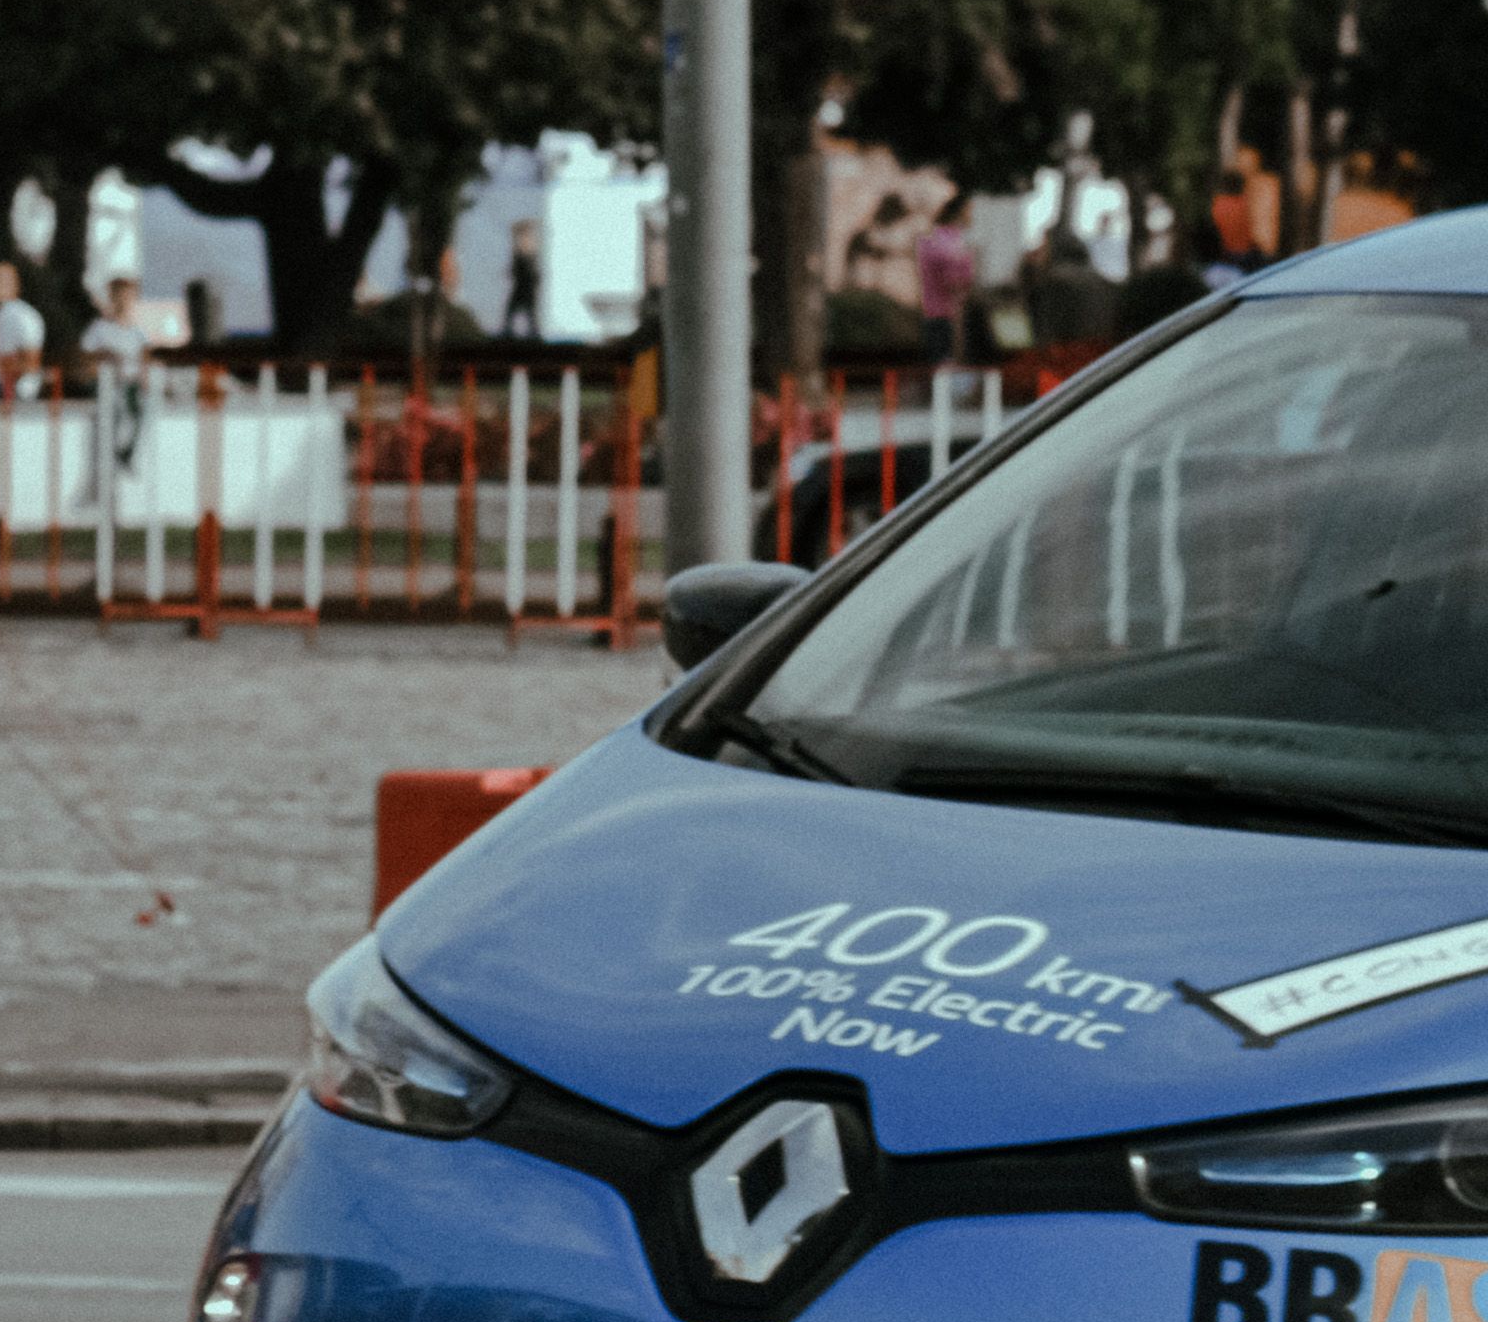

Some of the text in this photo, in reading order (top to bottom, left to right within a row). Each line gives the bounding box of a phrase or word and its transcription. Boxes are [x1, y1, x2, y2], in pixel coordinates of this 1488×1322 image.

[726, 901, 1175, 1015] 400 km
[676, 964, 1127, 1051] 100% Electric
[769, 1005, 942, 1058] Now
